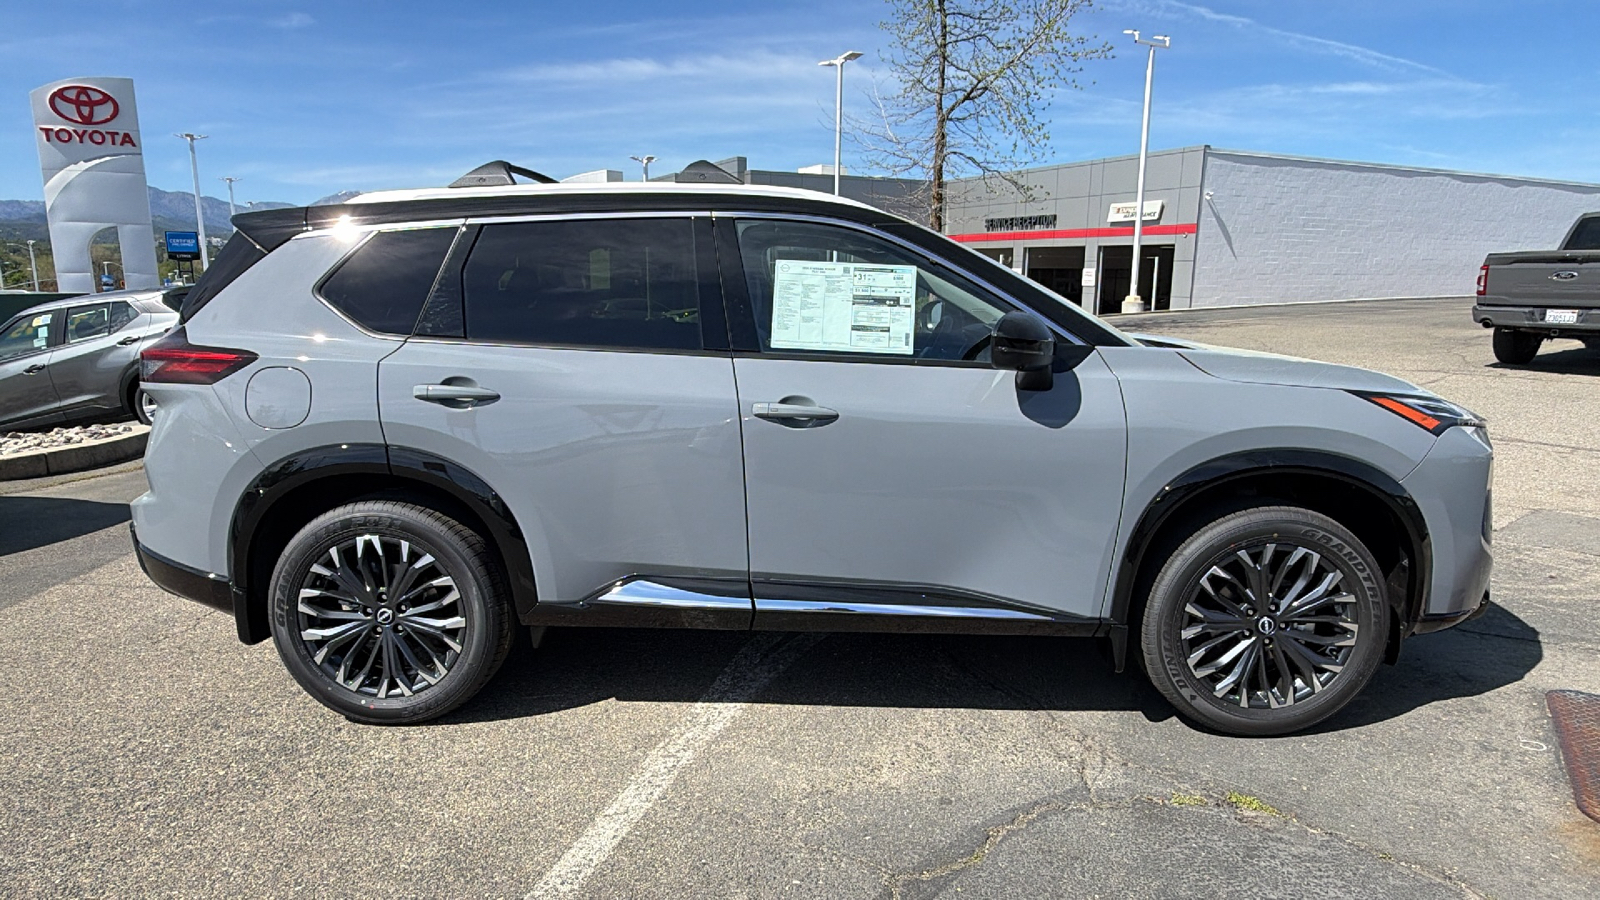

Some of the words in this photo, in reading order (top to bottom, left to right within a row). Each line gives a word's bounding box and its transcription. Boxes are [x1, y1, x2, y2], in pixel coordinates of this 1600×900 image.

[39, 127, 136, 147] TOYOTA
[985, 217, 1014, 230] SERVICE
[1014, 214, 1057, 228] RECEPTION
